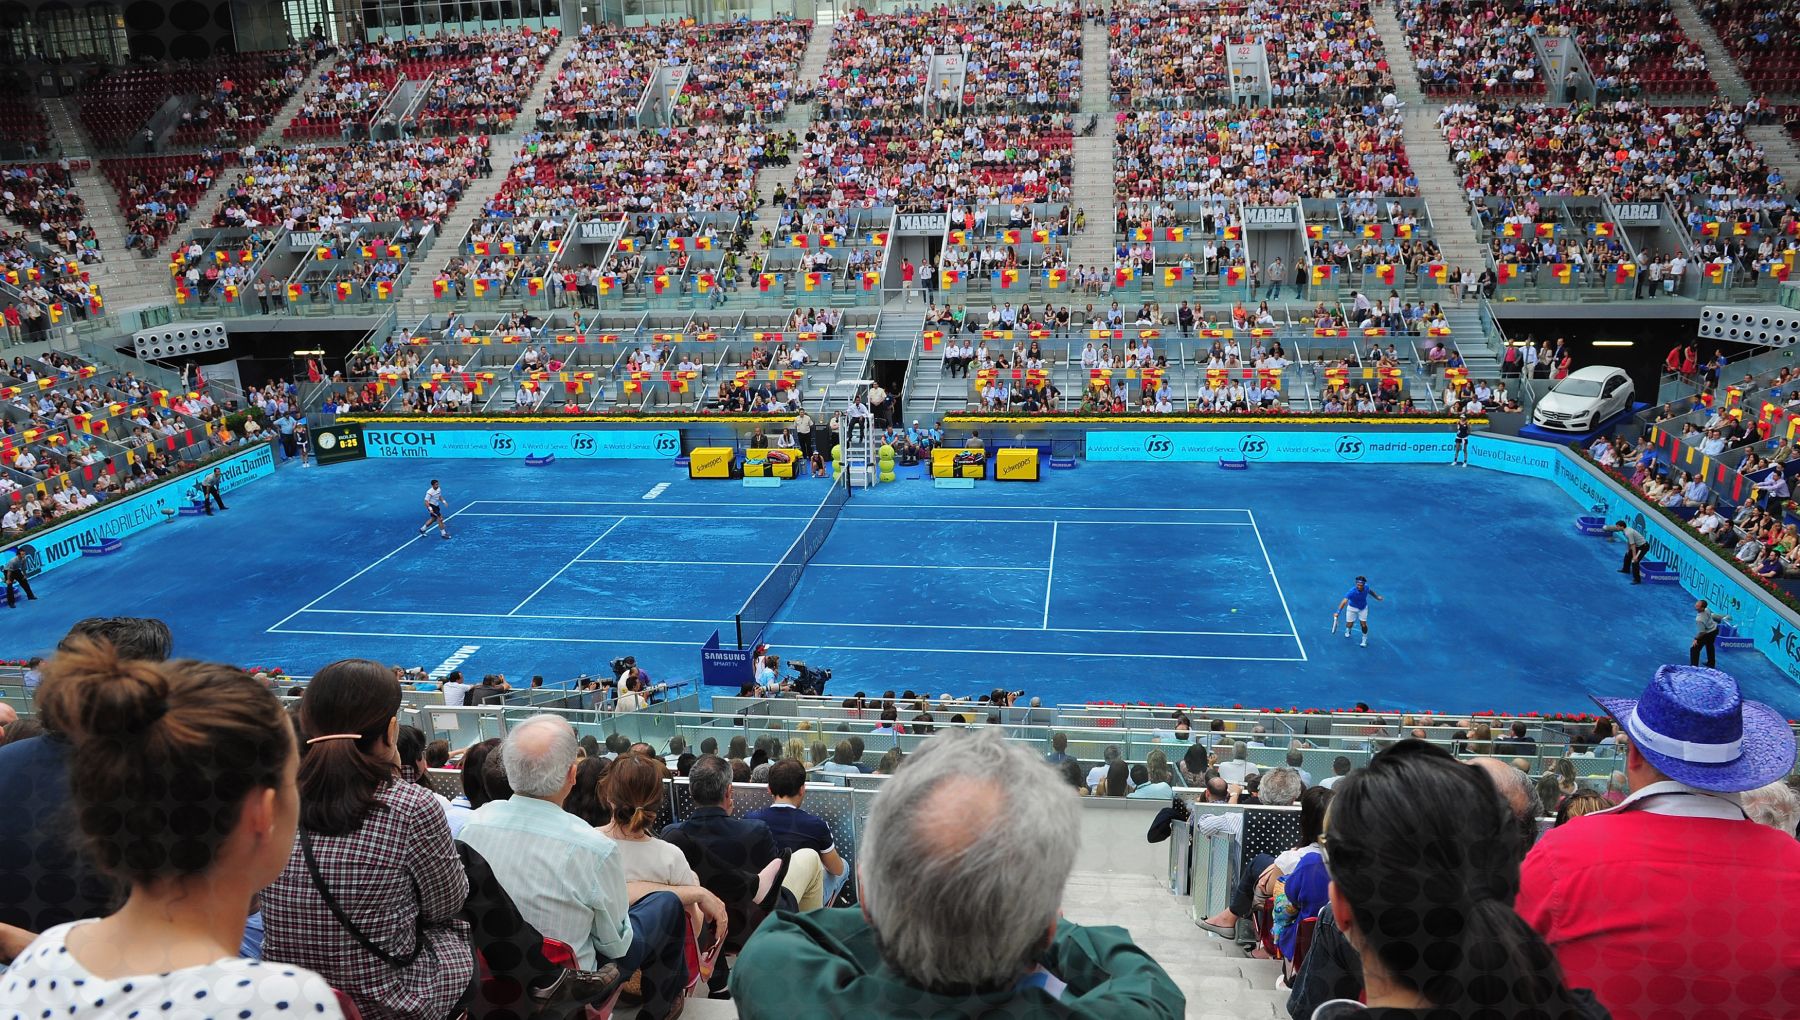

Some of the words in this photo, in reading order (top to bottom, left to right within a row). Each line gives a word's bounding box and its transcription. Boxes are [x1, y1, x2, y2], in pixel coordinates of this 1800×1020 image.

[1244, 208, 1292, 223] MARCA
[1612, 204, 1657, 220] MARCA
[900, 216, 945, 230] MARCA
[290, 232, 321, 246] MARC
[340, 439, 358, 448] 0:25
[368, 432, 436, 445] RICOH
[493, 434, 512, 449] iss
[575, 433, 594, 449] iss
[657, 433, 676, 450] iss
[1147, 434, 1170, 452] iss
[1242, 434, 1265, 452] iss
[1338, 436, 1362, 453] iss
[380, 446, 398, 456] 184
[401, 446, 428, 456] km/h
[1471, 445, 1549, 468] NuevoClaseA.com
[240, 454, 271, 473] Damm
[704, 653, 746, 661] SAMSUNG
